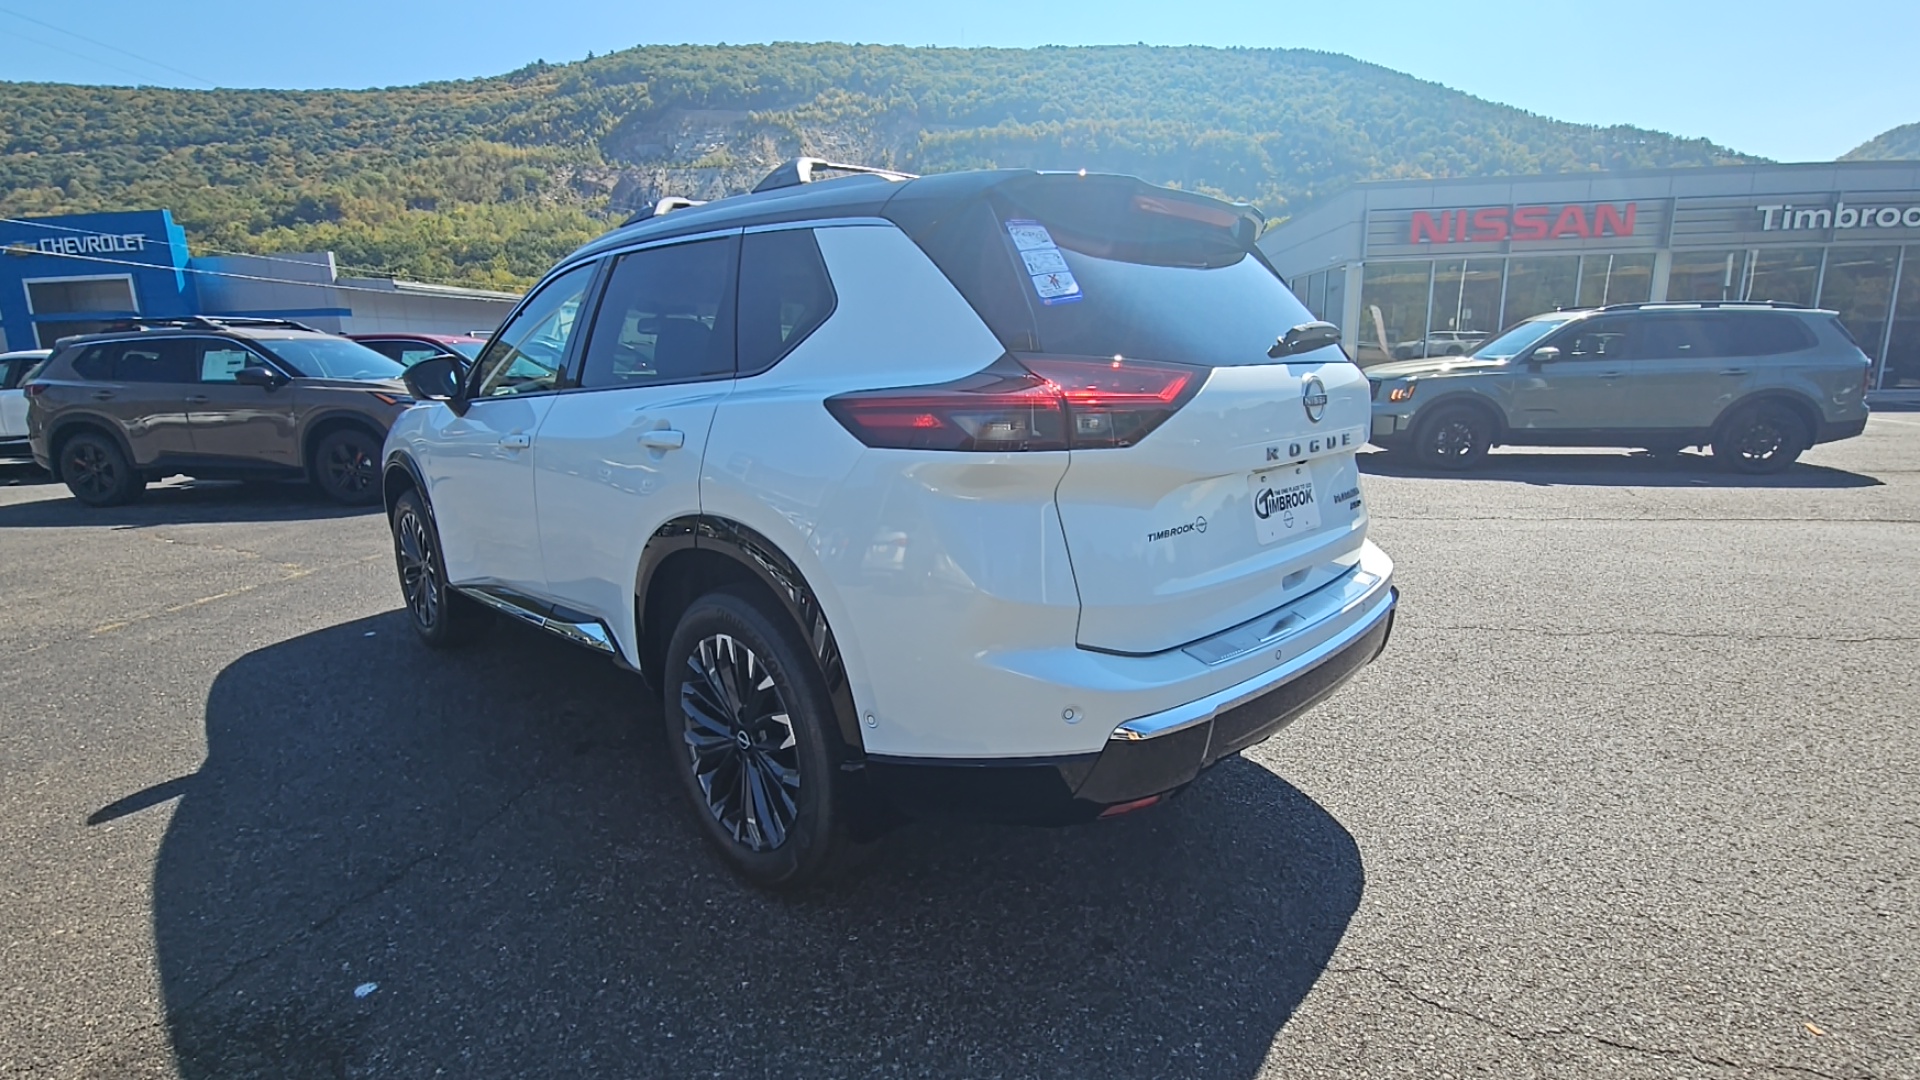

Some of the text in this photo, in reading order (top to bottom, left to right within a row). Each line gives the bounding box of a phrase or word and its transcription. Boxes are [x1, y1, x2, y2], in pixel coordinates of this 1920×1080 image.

[1410, 202, 1637, 245] NISSAN
[1757, 202, 1920, 231] Timbroo
[40, 234, 146, 254] CHEVROLET
[1266, 433, 1351, 462] ROGUE
[1255, 487, 1314, 519] TIMBROOK
[1147, 522, 1195, 542] TIMBROOK
